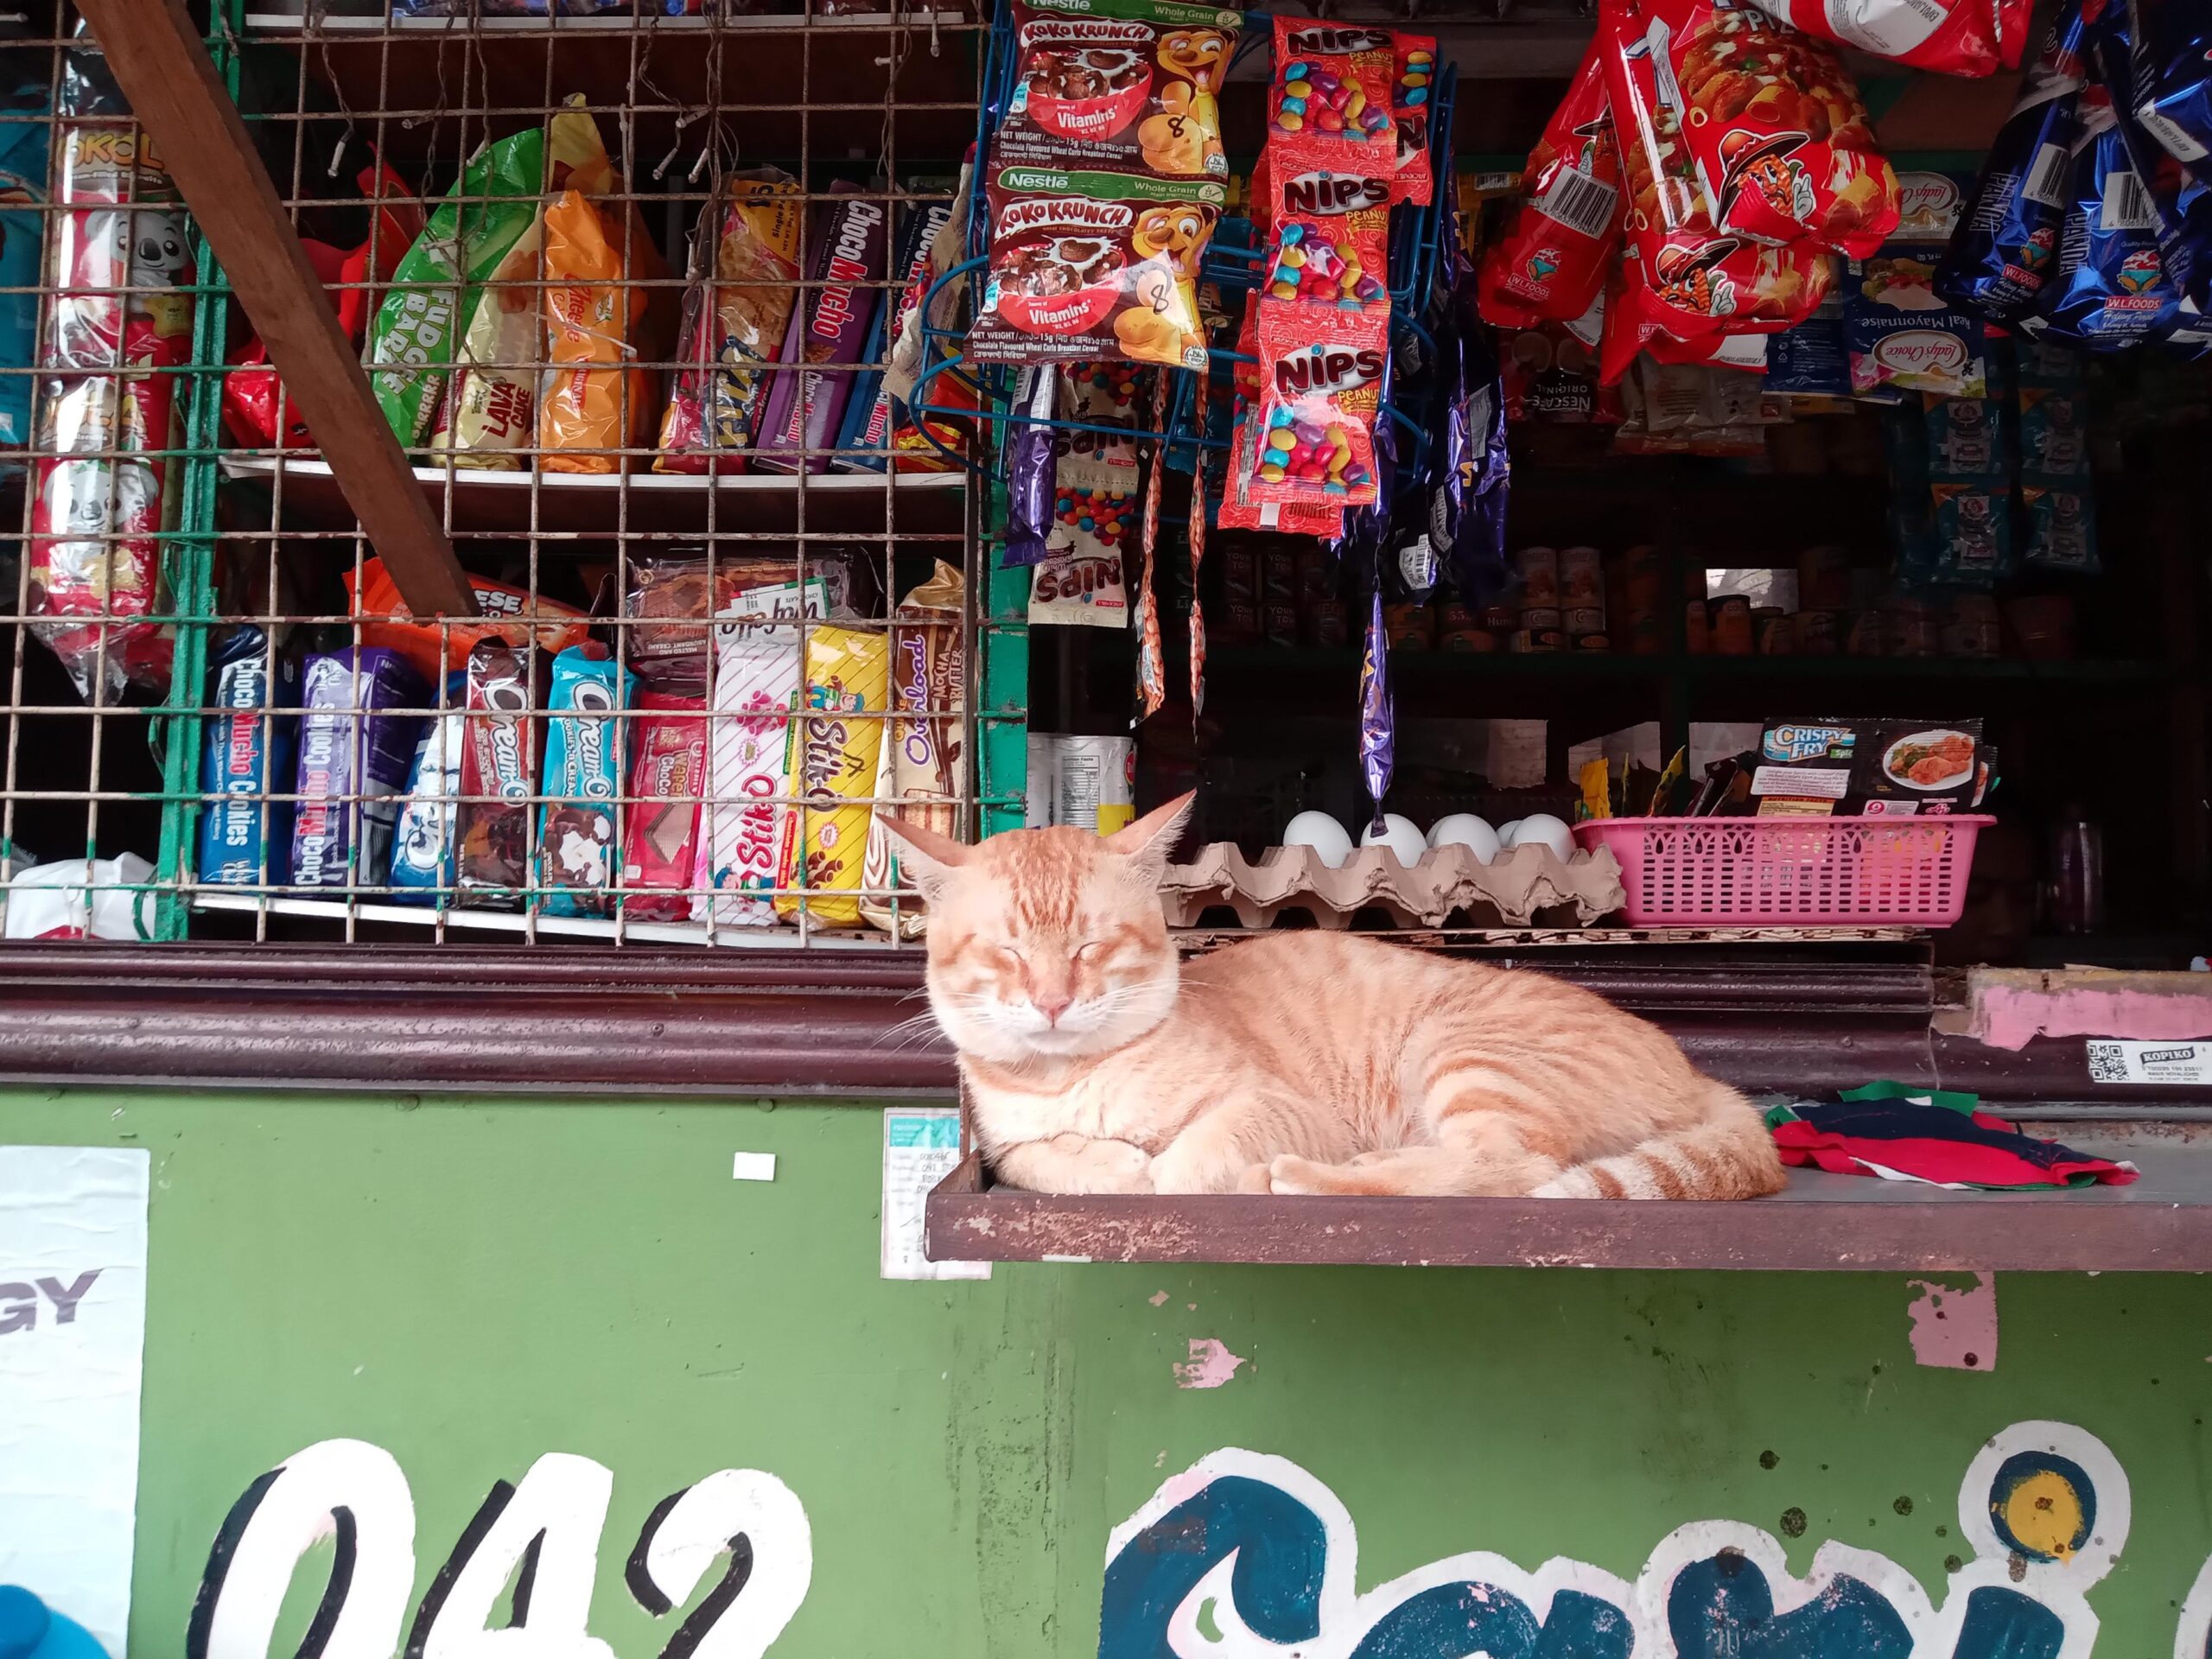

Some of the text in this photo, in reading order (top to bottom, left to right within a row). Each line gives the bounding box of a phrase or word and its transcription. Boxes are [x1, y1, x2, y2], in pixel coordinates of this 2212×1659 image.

[1154, 5, 1186, 17] Whole
[1187, 10, 1215, 21] Grain
[1072, 22, 1149, 41] KRUNCH
[1000, 130, 1013, 140] NET
[1166, 114, 1187, 139] 8
[1134, 181, 1167, 194] Whole
[1168, 185, 1198, 196] Grain
[1969, 173, 2021, 232] PANDA
[1000, 201, 1126, 232] KOKO KRUNCH
[1150, 283, 1170, 315] 8
[1861, 315, 1971, 330] Real Mayonnaise
[972, 331, 985, 340] NET
[1039, 334, 1053, 344] 15g
[1026, 343, 1041, 352] Wheat
[1885, 340, 1958, 363] Lady's Choice
[481, 382, 516, 438] LAVA
[510, 386, 531, 430] CAKE
[563, 716, 577, 750] OOKIES
[1776, 724, 1845, 746] CRISPY
[1790, 741, 1831, 760] FRY
[226, 780, 257, 847] Cookies
[2143, 1049, 2192, 1062] KOPIKO
